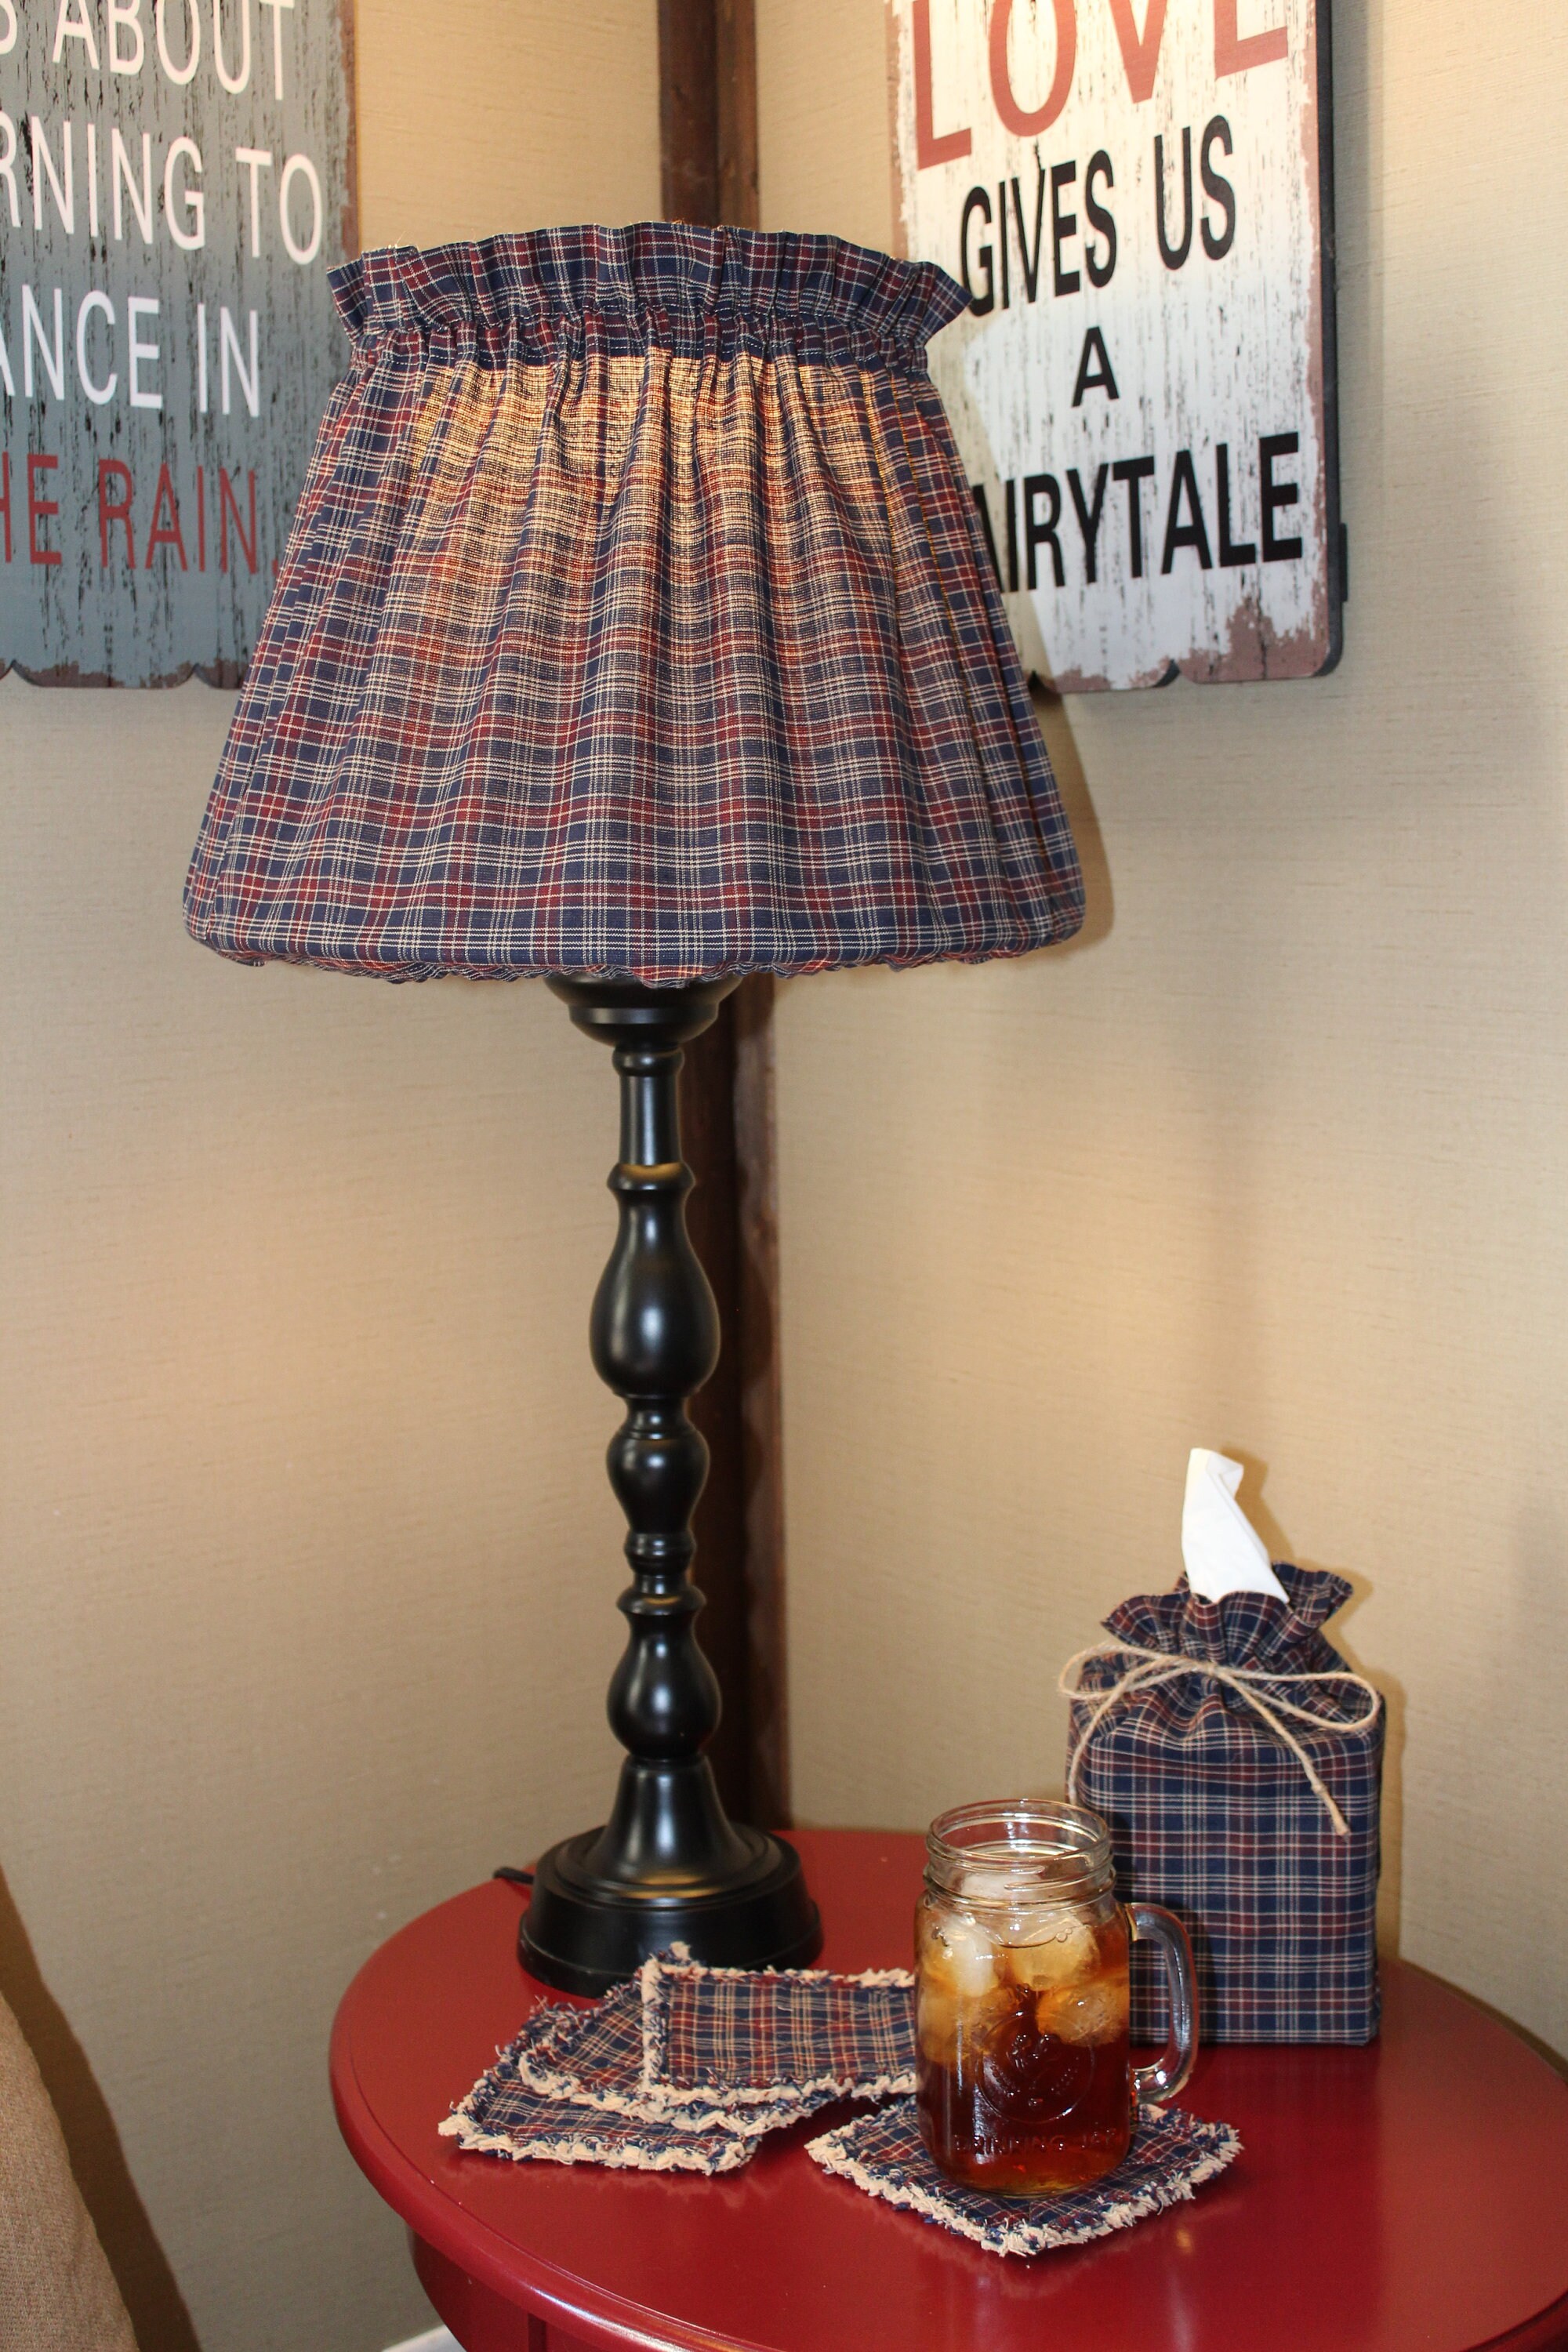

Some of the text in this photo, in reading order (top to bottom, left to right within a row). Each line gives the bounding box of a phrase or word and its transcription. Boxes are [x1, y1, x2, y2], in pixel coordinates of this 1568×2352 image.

[53, 0, 296, 100] ABOUT
[235, 147, 322, 265] TO
[960, 114, 1236, 318] GIVES US
[198, 303, 259, 418] IN
[1071, 326, 1120, 408] A
